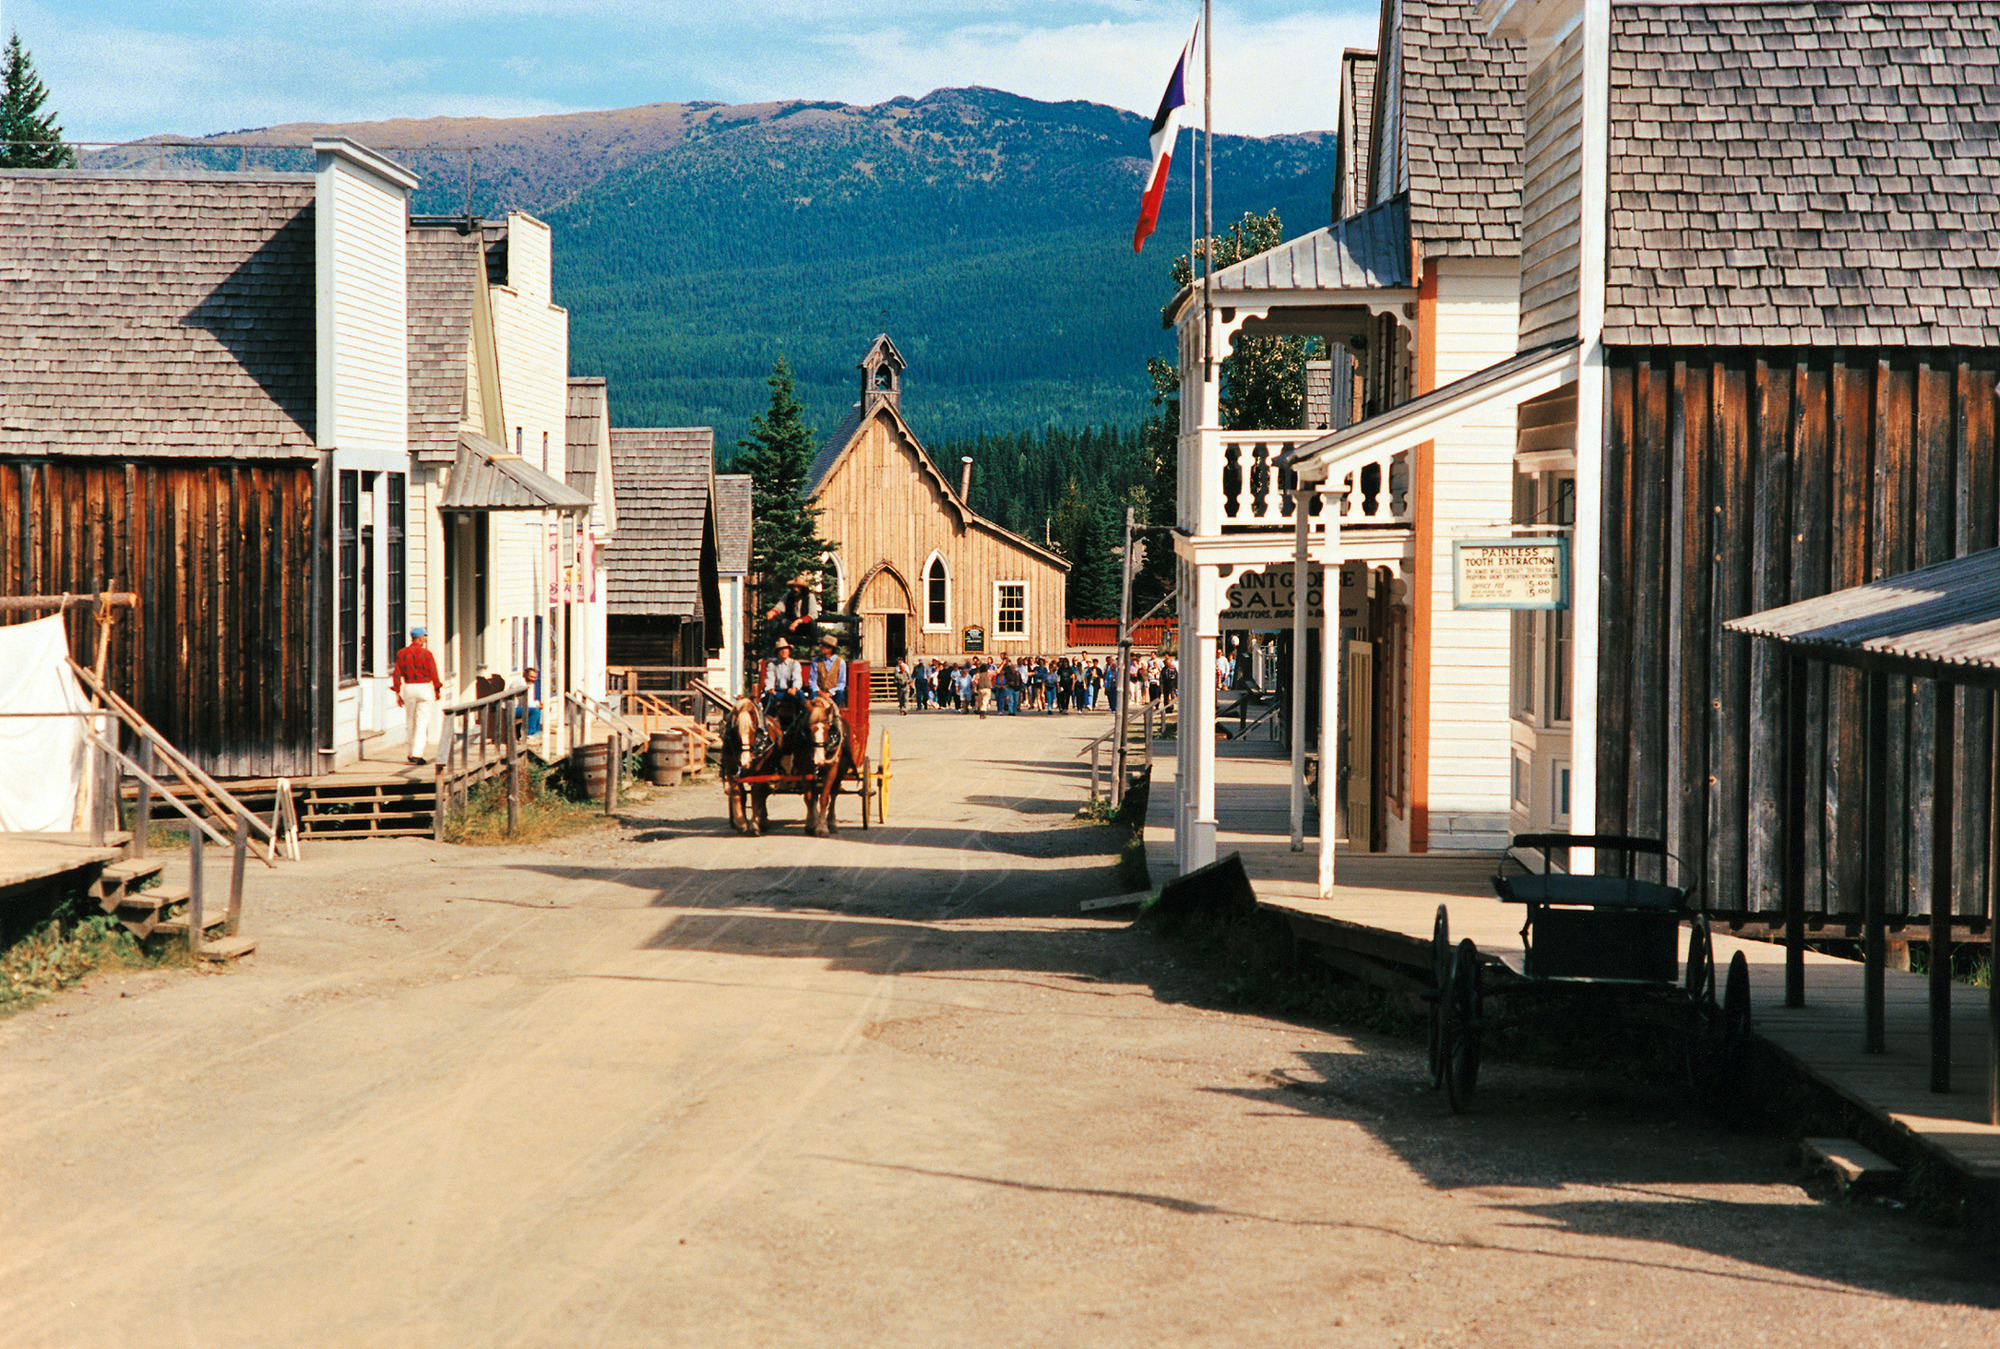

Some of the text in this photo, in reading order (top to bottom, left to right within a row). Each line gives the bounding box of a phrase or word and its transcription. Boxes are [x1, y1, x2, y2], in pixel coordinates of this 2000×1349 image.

[1482, 547, 1539, 557] PAINLESS
[1465, 556, 1555, 566] TOOTH EXTRACTION
[1231, 572, 1277, 589] AINT
